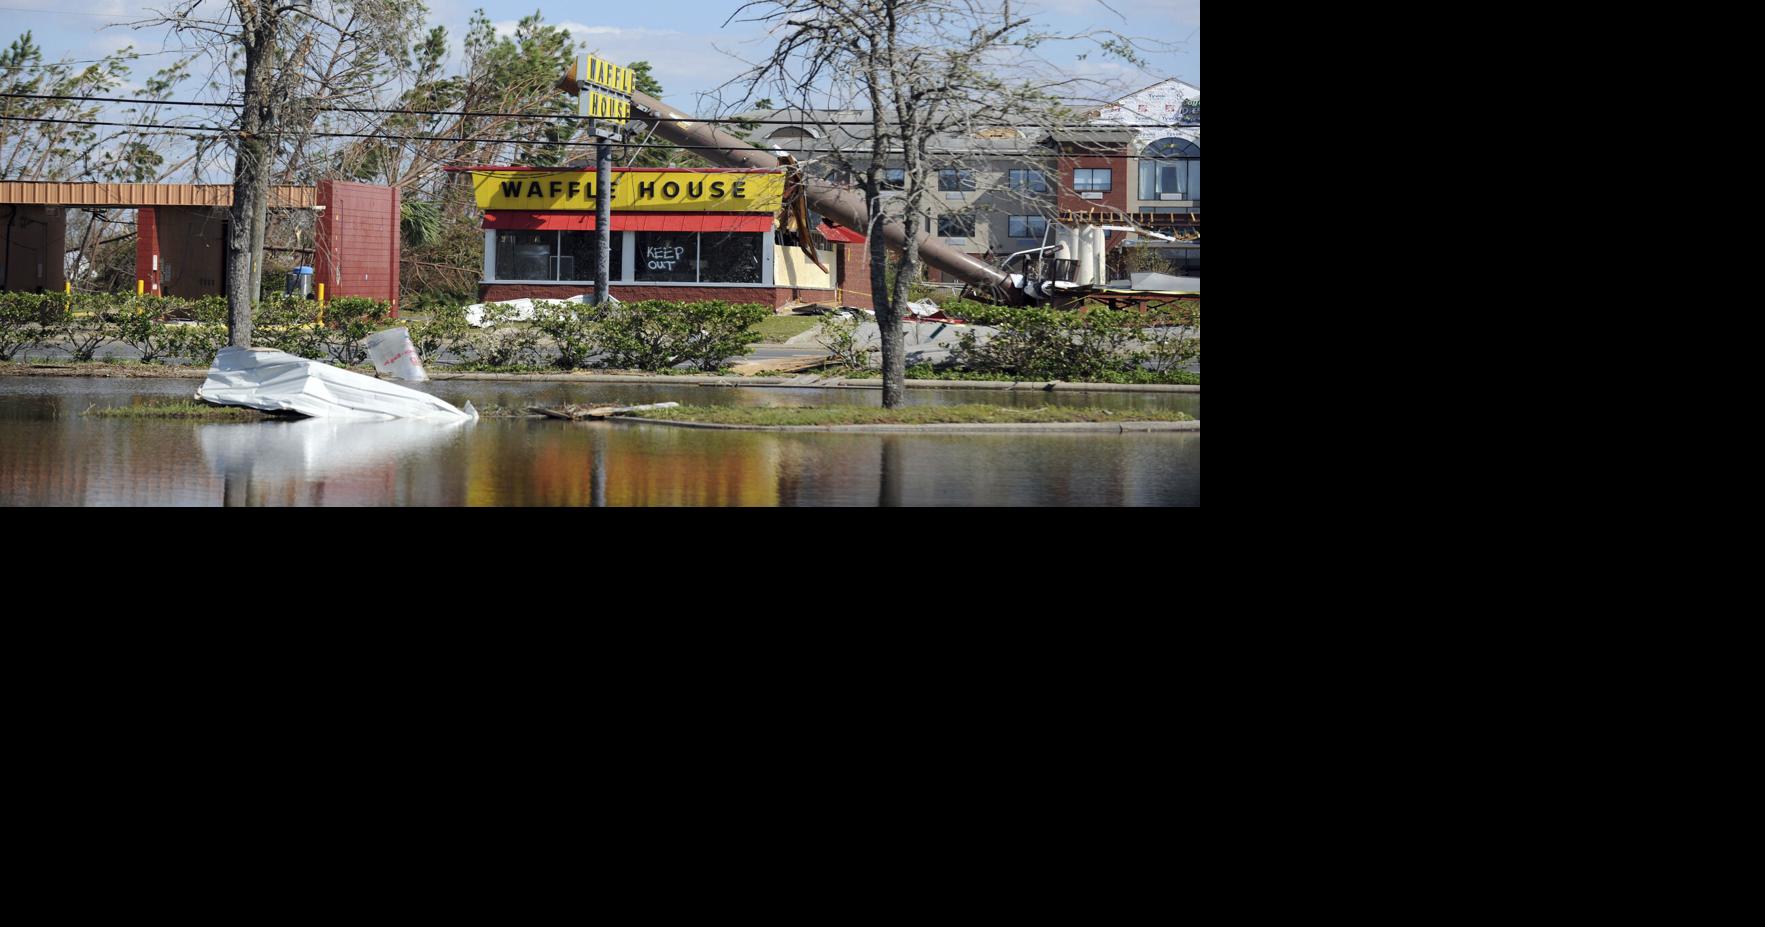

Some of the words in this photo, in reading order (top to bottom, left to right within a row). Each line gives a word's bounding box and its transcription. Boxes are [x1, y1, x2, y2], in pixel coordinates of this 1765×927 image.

[590, 57, 636, 93] WAFFLE
[592, 93, 631, 123] HOUSE
[639, 181, 746, 199] HOUSE
[647, 246, 684, 260] KEEP
[647, 260, 676, 271] OUT
